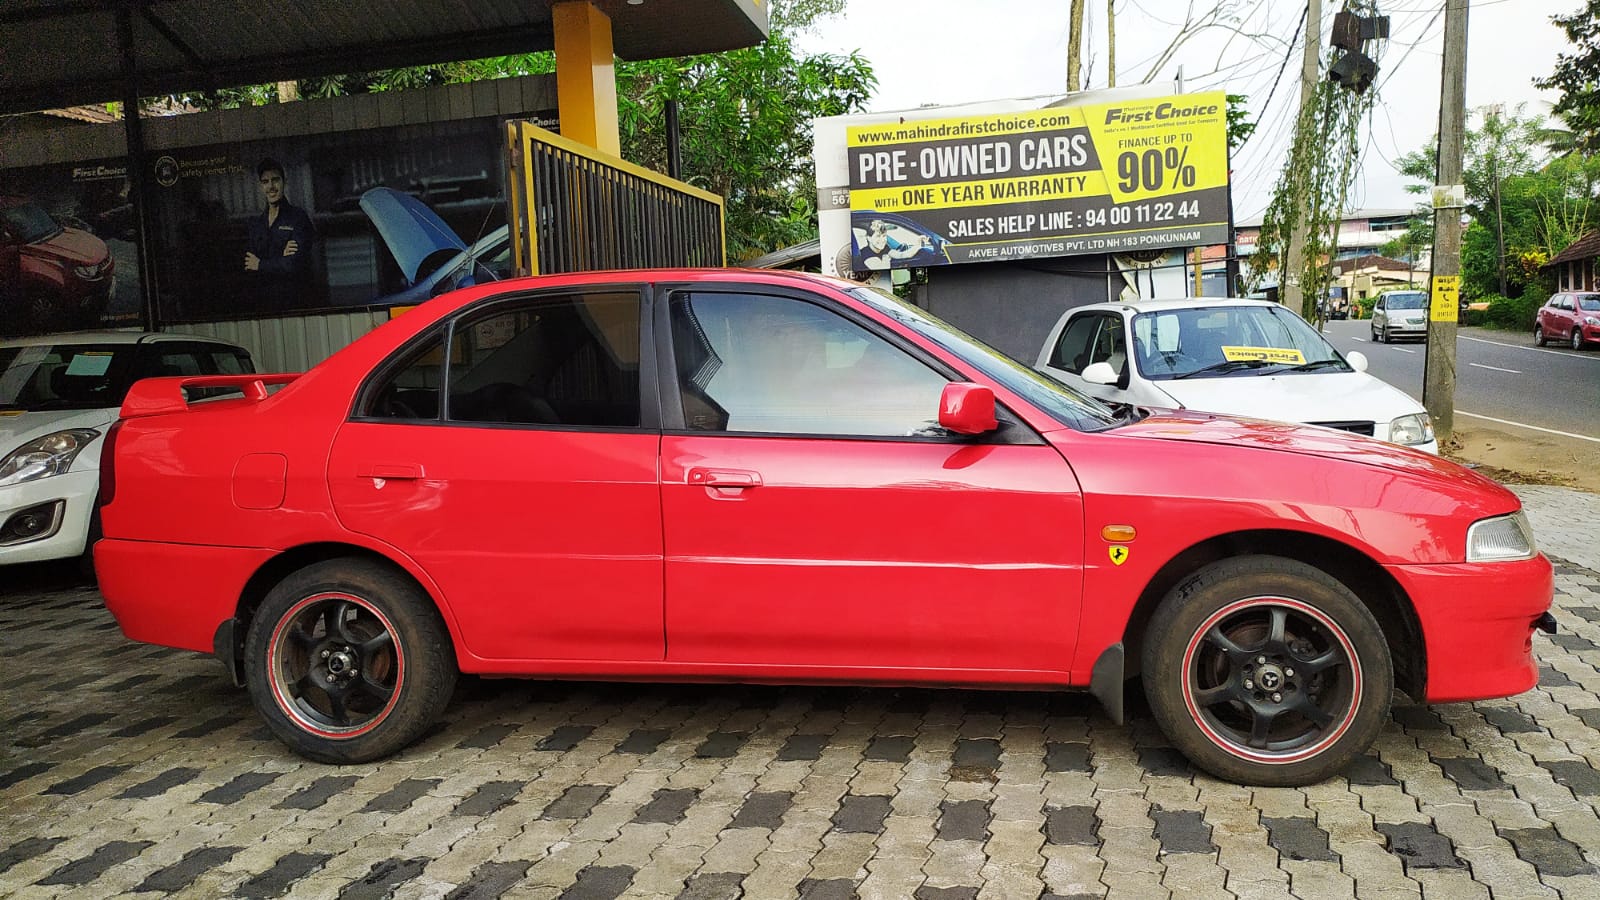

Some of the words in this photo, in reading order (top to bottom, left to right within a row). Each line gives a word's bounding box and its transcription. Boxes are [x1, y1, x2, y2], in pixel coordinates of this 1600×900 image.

[858, 114, 1071, 143] www.mahindrafirstchoice.com
[1104, 108, 1153, 125] First
[1155, 103, 1218, 120] Choice
[1019, 134, 1088, 171] CARS
[1118, 136, 1161, 149] FINANCE
[1164, 134, 1177, 144] UP
[1180, 133, 1193, 142] TO
[1117, 145, 1196, 194] 90%
[874, 197, 898, 209] WITH
[902, 189, 936, 207] ONE
[940, 185, 984, 204] YEAR
[990, 176, 1087, 198] WARRANTY
[948, 218, 994, 238] SALES
[998, 214, 1035, 234] HELP
[1039, 211, 1073, 231] LINE
[1086, 208, 1106, 227] 94
[1110, 206, 1131, 225] 00
[1135, 204, 1150, 223] 11
[1154, 202, 1174, 221] 22
[1178, 199, 1199, 218] 44
[968, 248, 999, 259] AKVEE
[1000, 243, 1065, 257] AUTOMOTIVES
[1067, 241, 1086, 251] PVT.
[1087, 240, 1105, 249] LTD
[1107, 238, 1120, 247] NH
[1122, 236, 1138, 246] 183
[1139, 231, 1201, 245] PONKUNNAM
